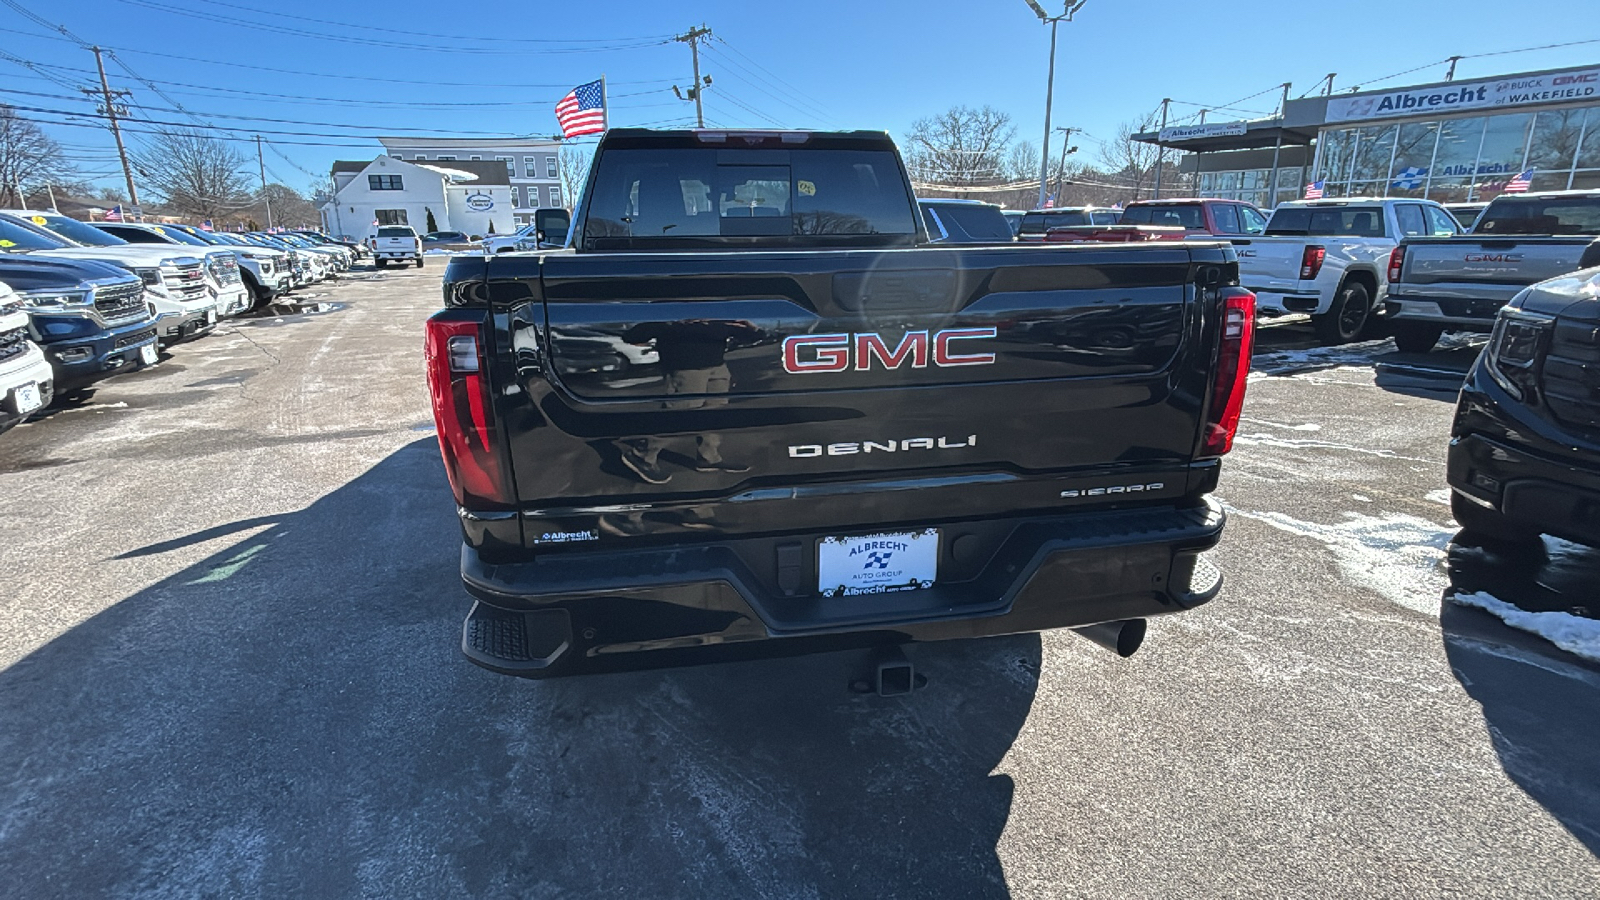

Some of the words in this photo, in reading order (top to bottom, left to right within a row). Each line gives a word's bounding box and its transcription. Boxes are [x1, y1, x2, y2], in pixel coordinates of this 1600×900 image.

[1511, 80, 1542, 90] BUICK
[1553, 73, 1598, 86] GMC
[1377, 85, 1487, 112] Albrecht
[1509, 87, 1594, 102] WAKEFIELD
[1172, 128, 1206, 137] Albrecht
[1444, 163, 1510, 175] Albrecht
[1465, 253, 1525, 262] GMC
[781, 326, 998, 374] GMC
[788, 434, 977, 458] DENALI
[1060, 482, 1164, 498] SIERRA
[551, 530, 591, 540] Albrecht
[849, 541, 909, 557] ALBRECHT
[852, 572, 874, 580] AUTO
[875, 570, 903, 579] GROUP
[843, 585, 886, 597] Albrecht
